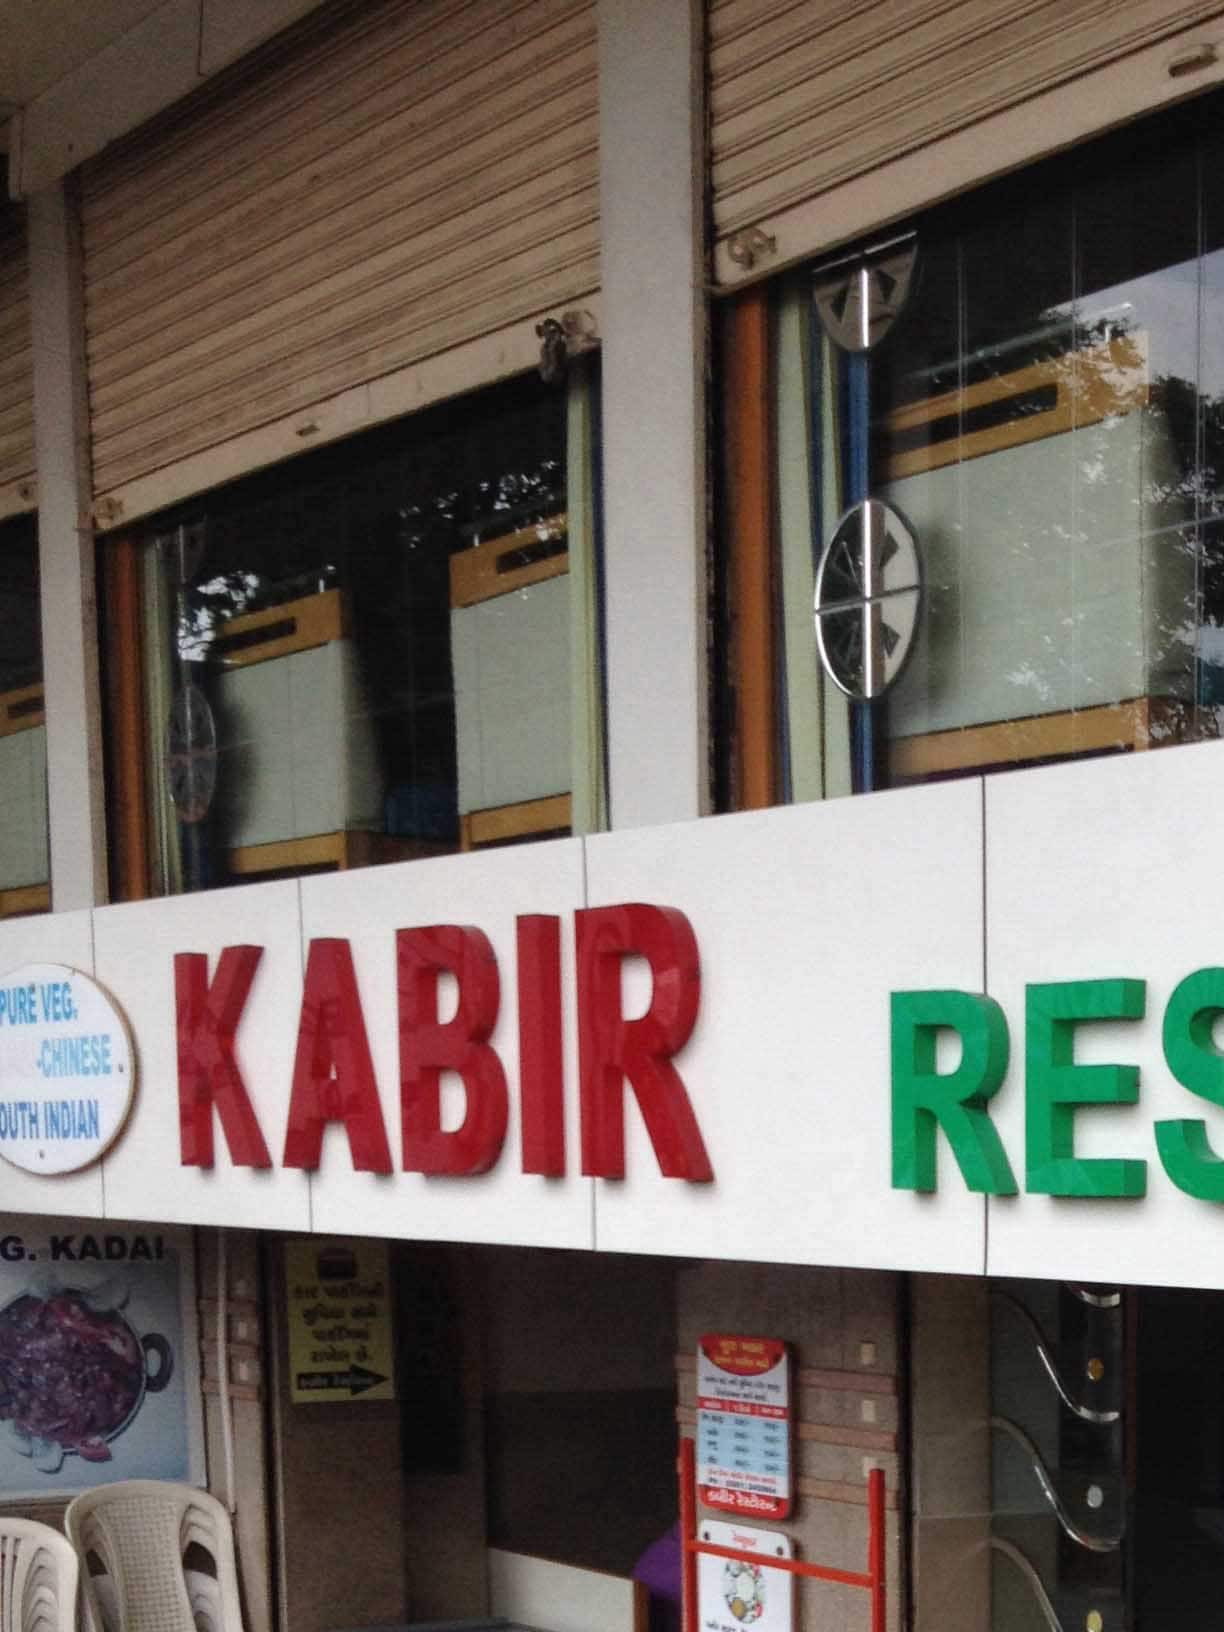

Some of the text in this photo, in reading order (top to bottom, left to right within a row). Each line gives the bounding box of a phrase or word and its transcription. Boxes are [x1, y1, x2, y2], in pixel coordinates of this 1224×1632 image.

[174, 902, 714, 1183] KABIR
[44, 1099, 100, 1140] INDIAN
[51, 1234, 166, 1261] KADAI
